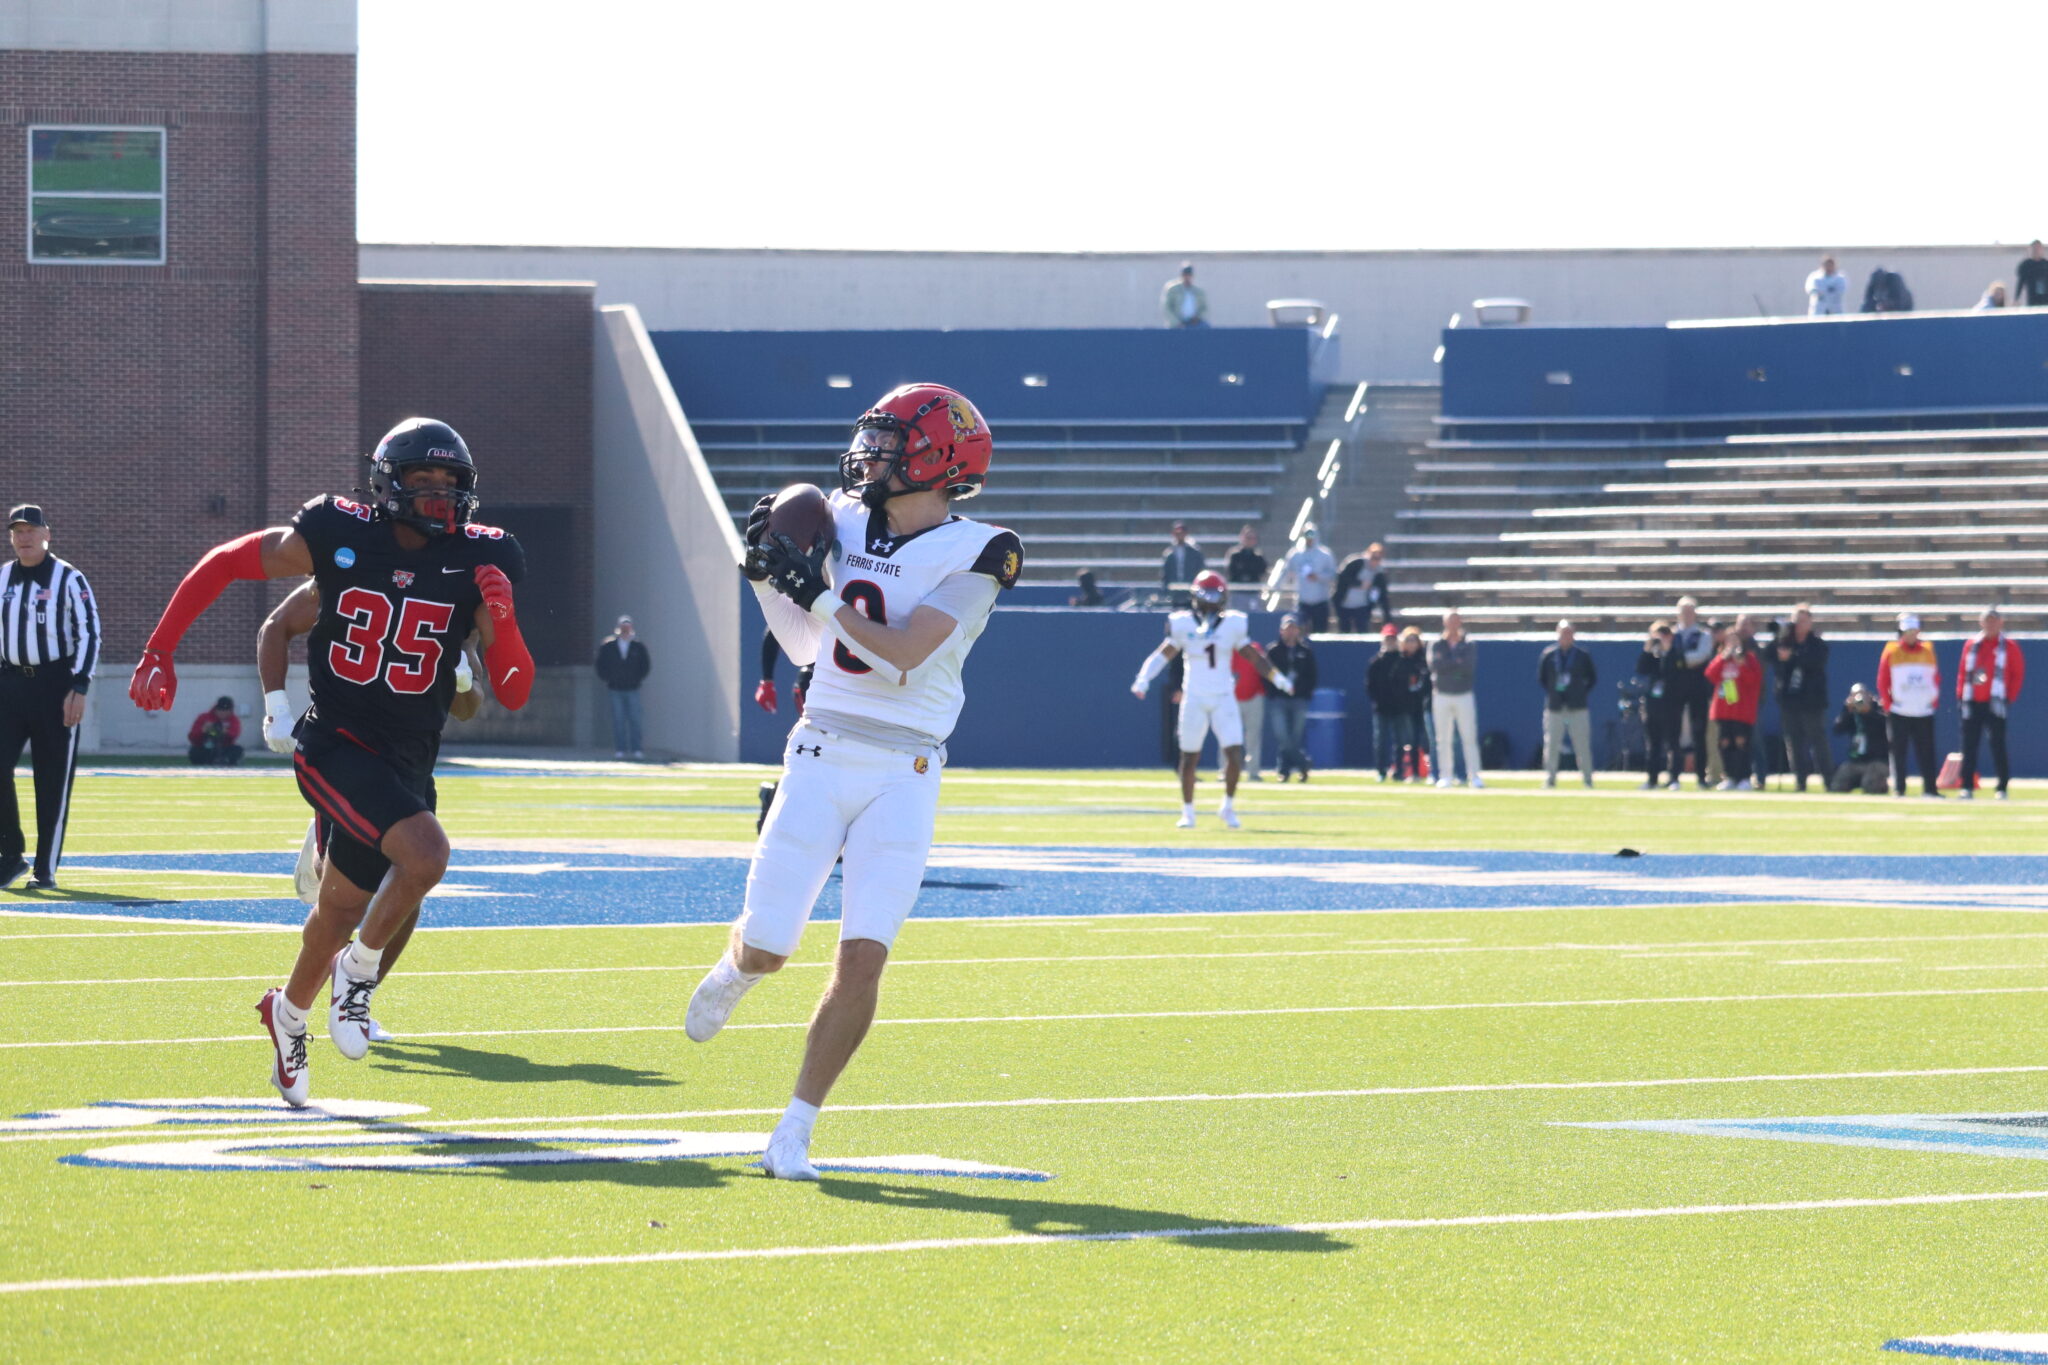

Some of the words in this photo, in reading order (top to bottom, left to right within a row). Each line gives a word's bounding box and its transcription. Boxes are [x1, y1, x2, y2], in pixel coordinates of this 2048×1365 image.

[846, 554, 874, 571] FERRIS
[874, 561, 902, 578] STATE
[37, 612, 46, 625] U
[328, 586, 455, 695] 35
[1204, 643, 1216, 669] 1
